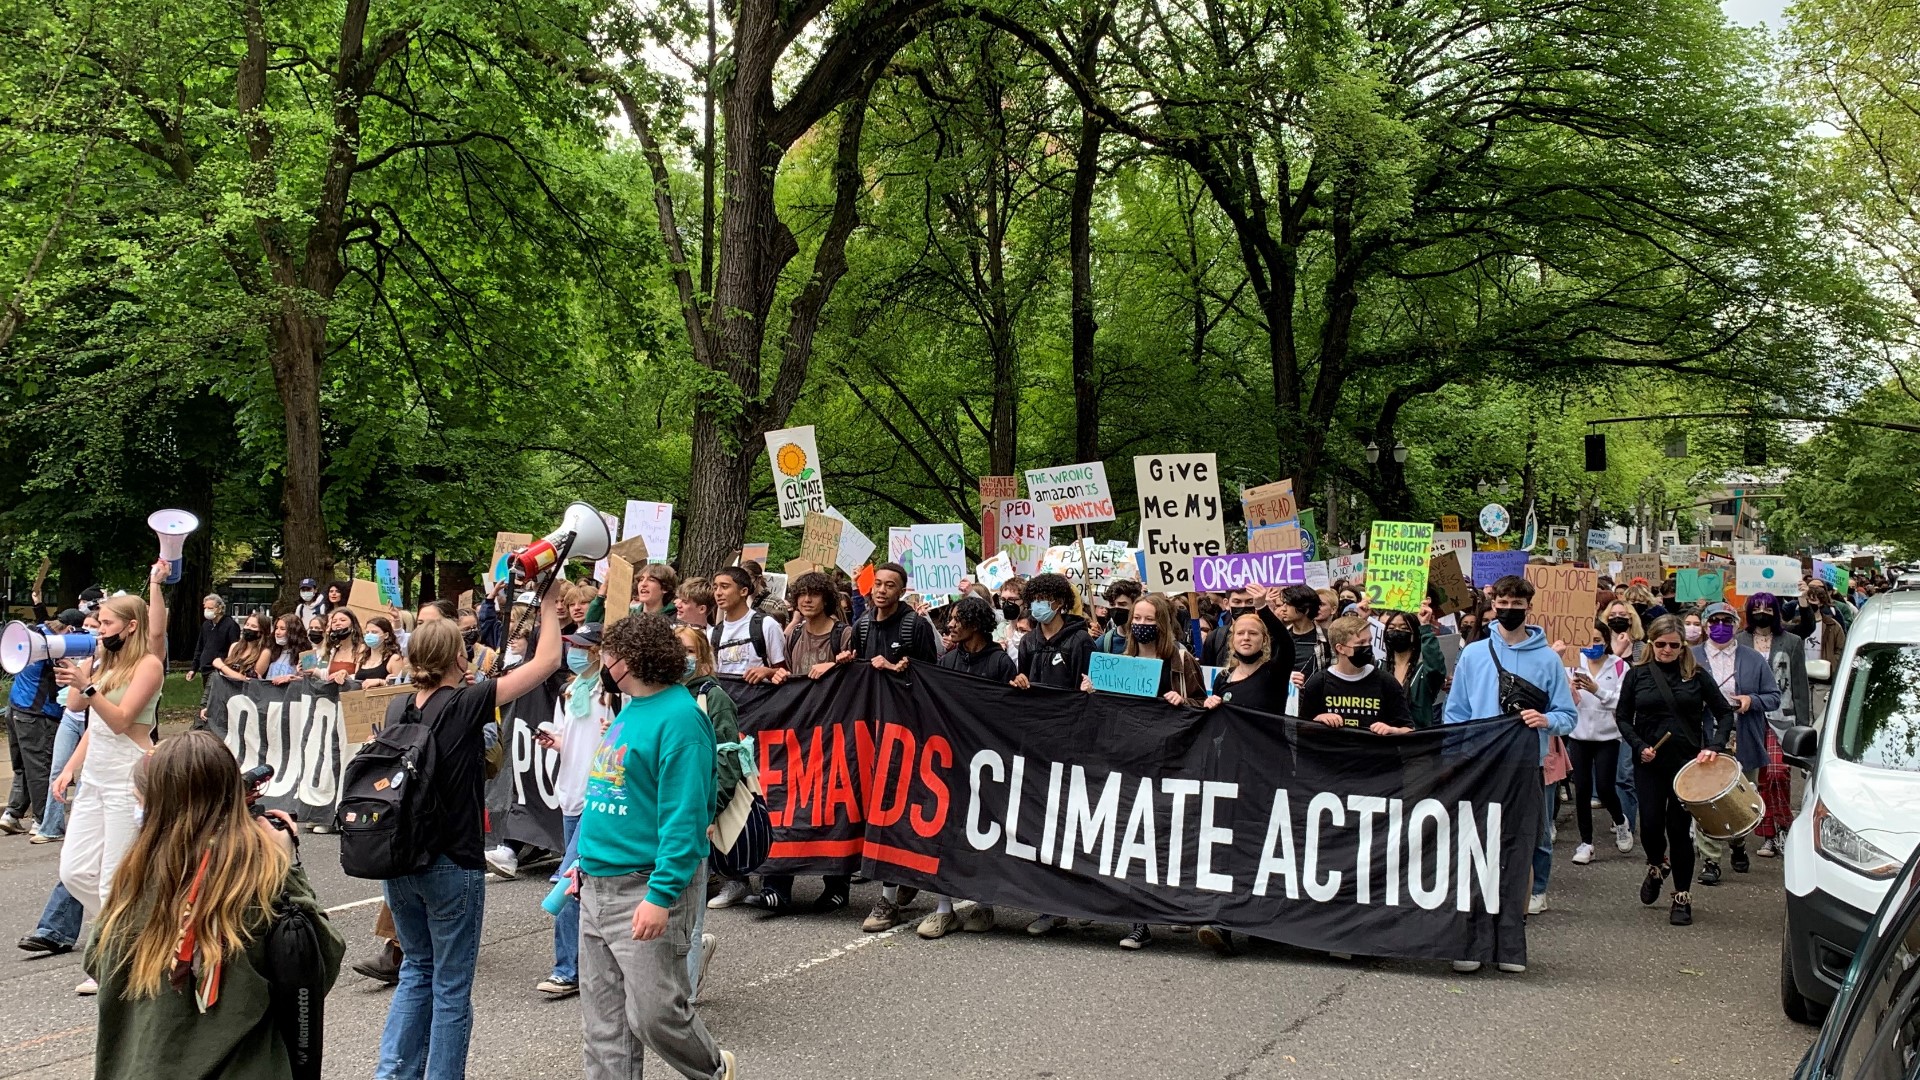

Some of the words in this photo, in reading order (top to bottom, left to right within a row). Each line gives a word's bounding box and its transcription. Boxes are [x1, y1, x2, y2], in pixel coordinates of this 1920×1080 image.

[1028, 473, 1046, 485] THE
[1050, 467, 1093, 484] WRONG
[1150, 458, 1208, 482] Give
[786, 479, 821, 499] CLIMATE
[980, 477, 1014, 488] CLIMATE
[980, 487, 1016, 498] EMERGENCY
[1034, 485, 1084, 502] amazon
[1085, 483, 1099, 496] IS
[783, 496, 824, 520] JUSTICE
[1007, 501, 1036, 519] PEO
[1052, 498, 1113, 522] BURNING
[1144, 495, 1178, 519] Me
[1184, 493, 1217, 521] My
[1002, 524, 1045, 541] OVER
[1375, 523, 1398, 538] THE
[1401, 524, 1431, 538] DINOS
[913, 534, 947, 559] SAVE
[1148, 529, 1220, 556] Future
[1375, 539, 1429, 553] THOUGHT
[1372, 553, 1401, 566] THEY
[1402, 554, 1424, 566] HAD
[914, 564, 962, 590] mama
[1159, 561, 1194, 586] Ba
[1199, 552, 1304, 590] ORGANIZE
[1369, 568, 1406, 582] TIME
[1525, 567, 1548, 589] NO
[1555, 569, 1596, 592] MORE
[1368, 585, 1385, 605] 2
[1541, 590, 1572, 613] EMPTY
[1090, 670, 1131, 693] FAILING
[1325, 695, 1381, 710] SUNRISE
[1327, 708, 1378, 716] MOVEMENT
[591, 801, 628, 816] YORK
[757, 720, 953, 838] EMANDS
[965, 749, 1239, 893] CLIMATE
[1252, 788, 1502, 915] ACTION
[297, 987, 309, 1048] Manfrotto
